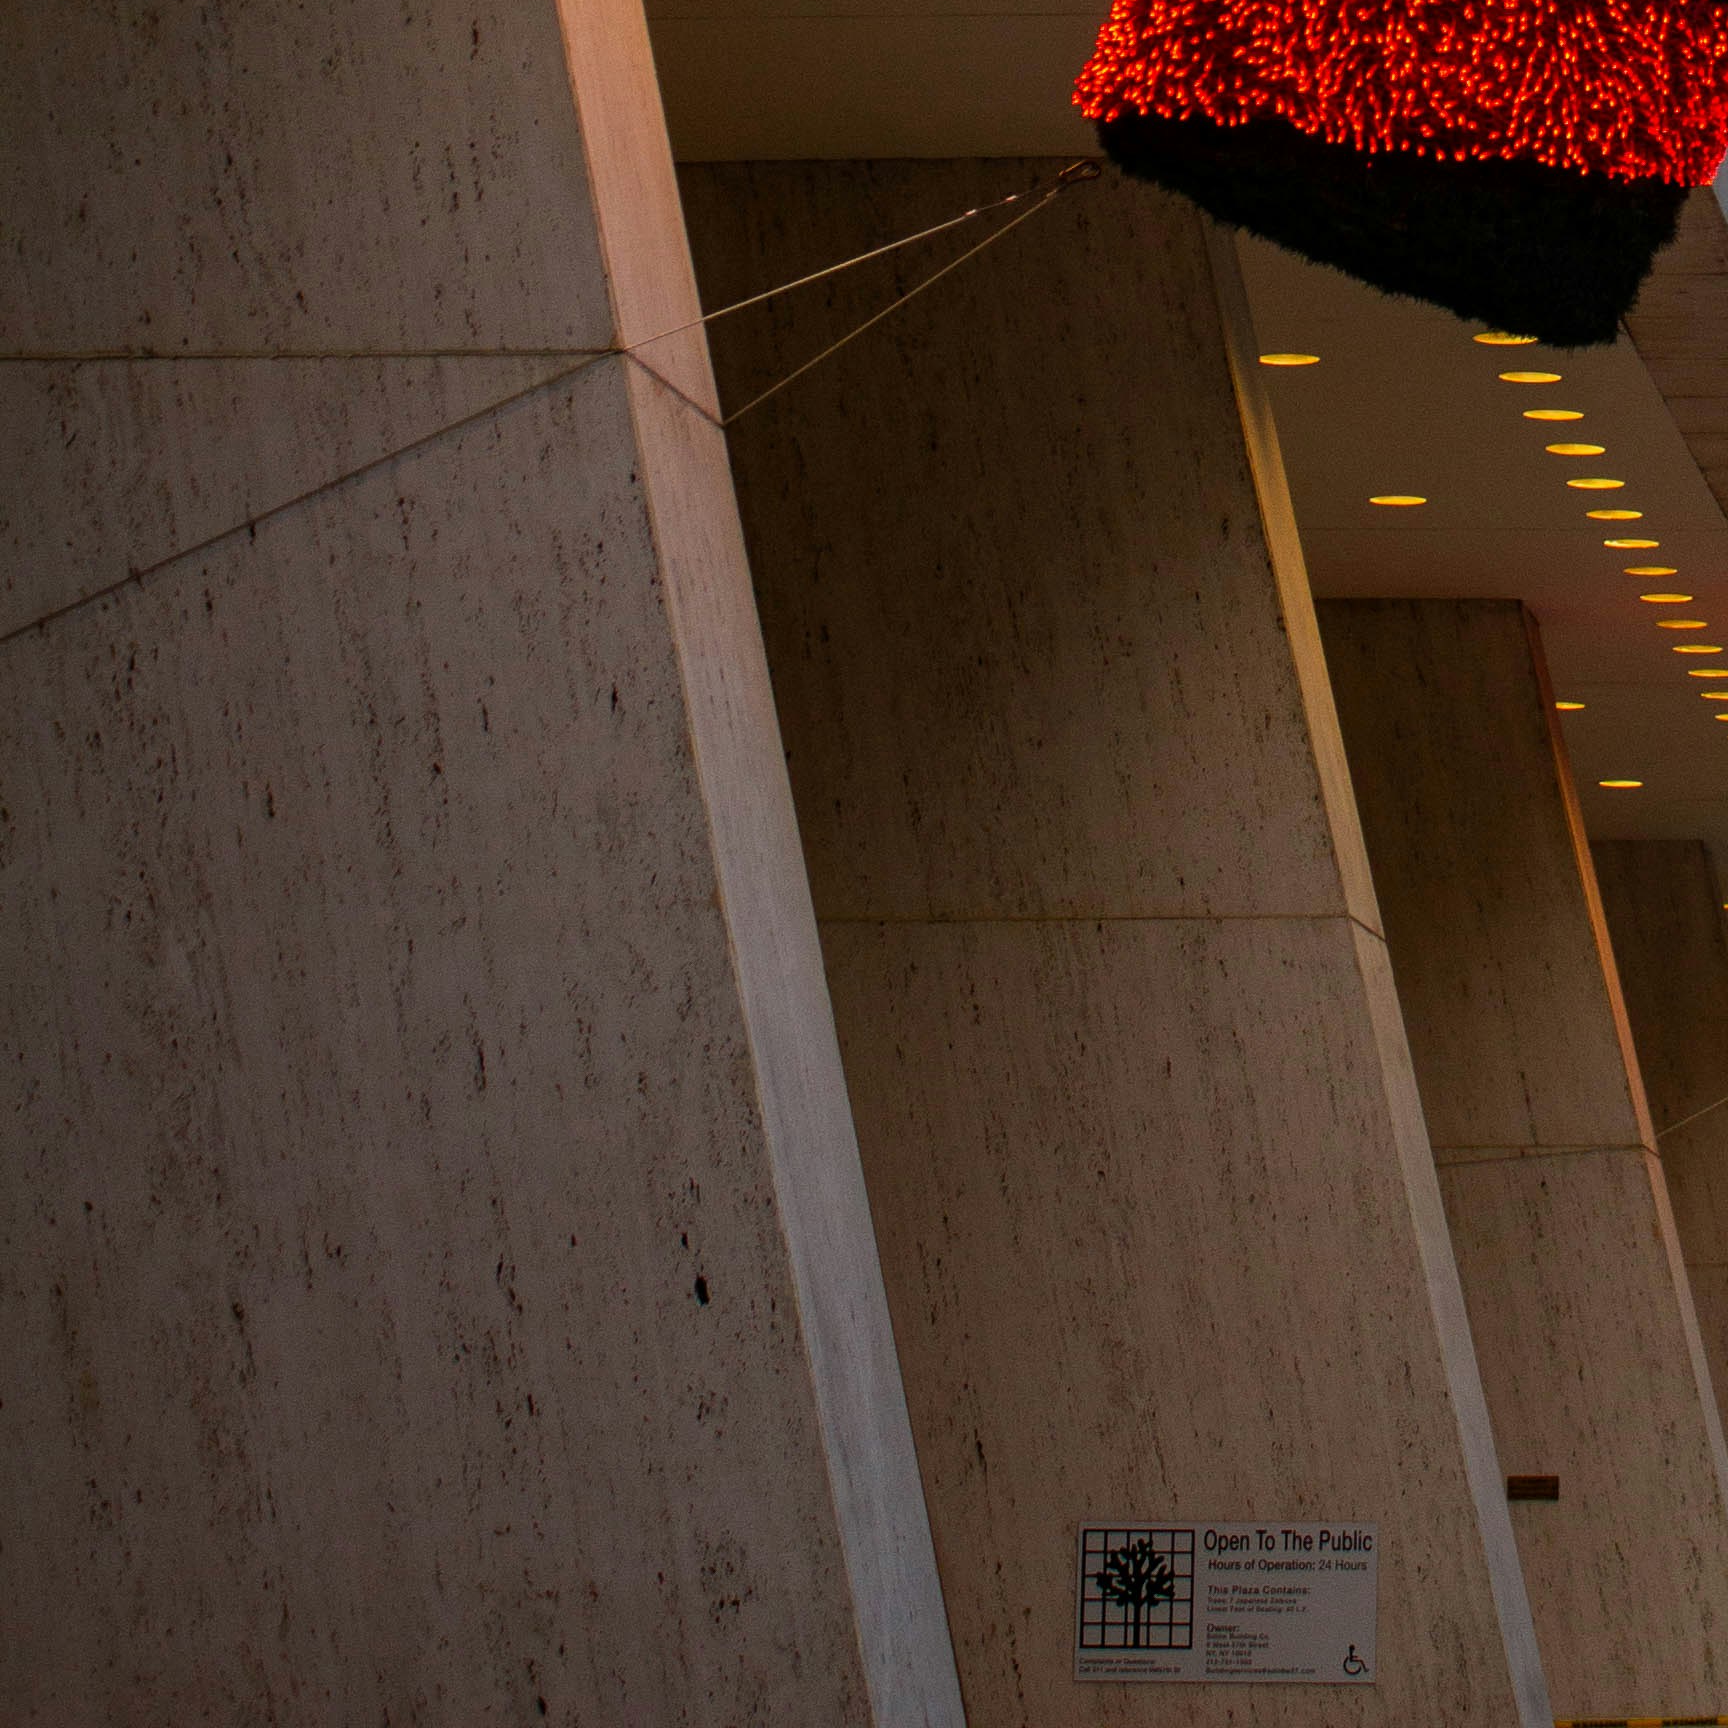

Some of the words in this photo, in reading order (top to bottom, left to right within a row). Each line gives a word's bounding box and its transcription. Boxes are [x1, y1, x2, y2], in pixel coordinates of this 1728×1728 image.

[1203, 1529, 1250, 1555] Open
[1255, 1529, 1275, 1551] To
[1280, 1529, 1313, 1551] The
[1318, 1529, 1373, 1551] Public
[1208, 1559, 1240, 1570] Hours
[1244, 1559, 1255, 1570] of
[1258, 1559, 1315, 1572] Operation:
[1318, 1560, 1332, 1570] 24
[1334, 1560, 1367, 1570] Hours
[1207, 1584, 1228, 1595] This
[1232, 1584, 1260, 1595] Plaza
[1262, 1584, 1311, 1595] Contains:
[1206, 1623, 1240, 1633] Owner:
